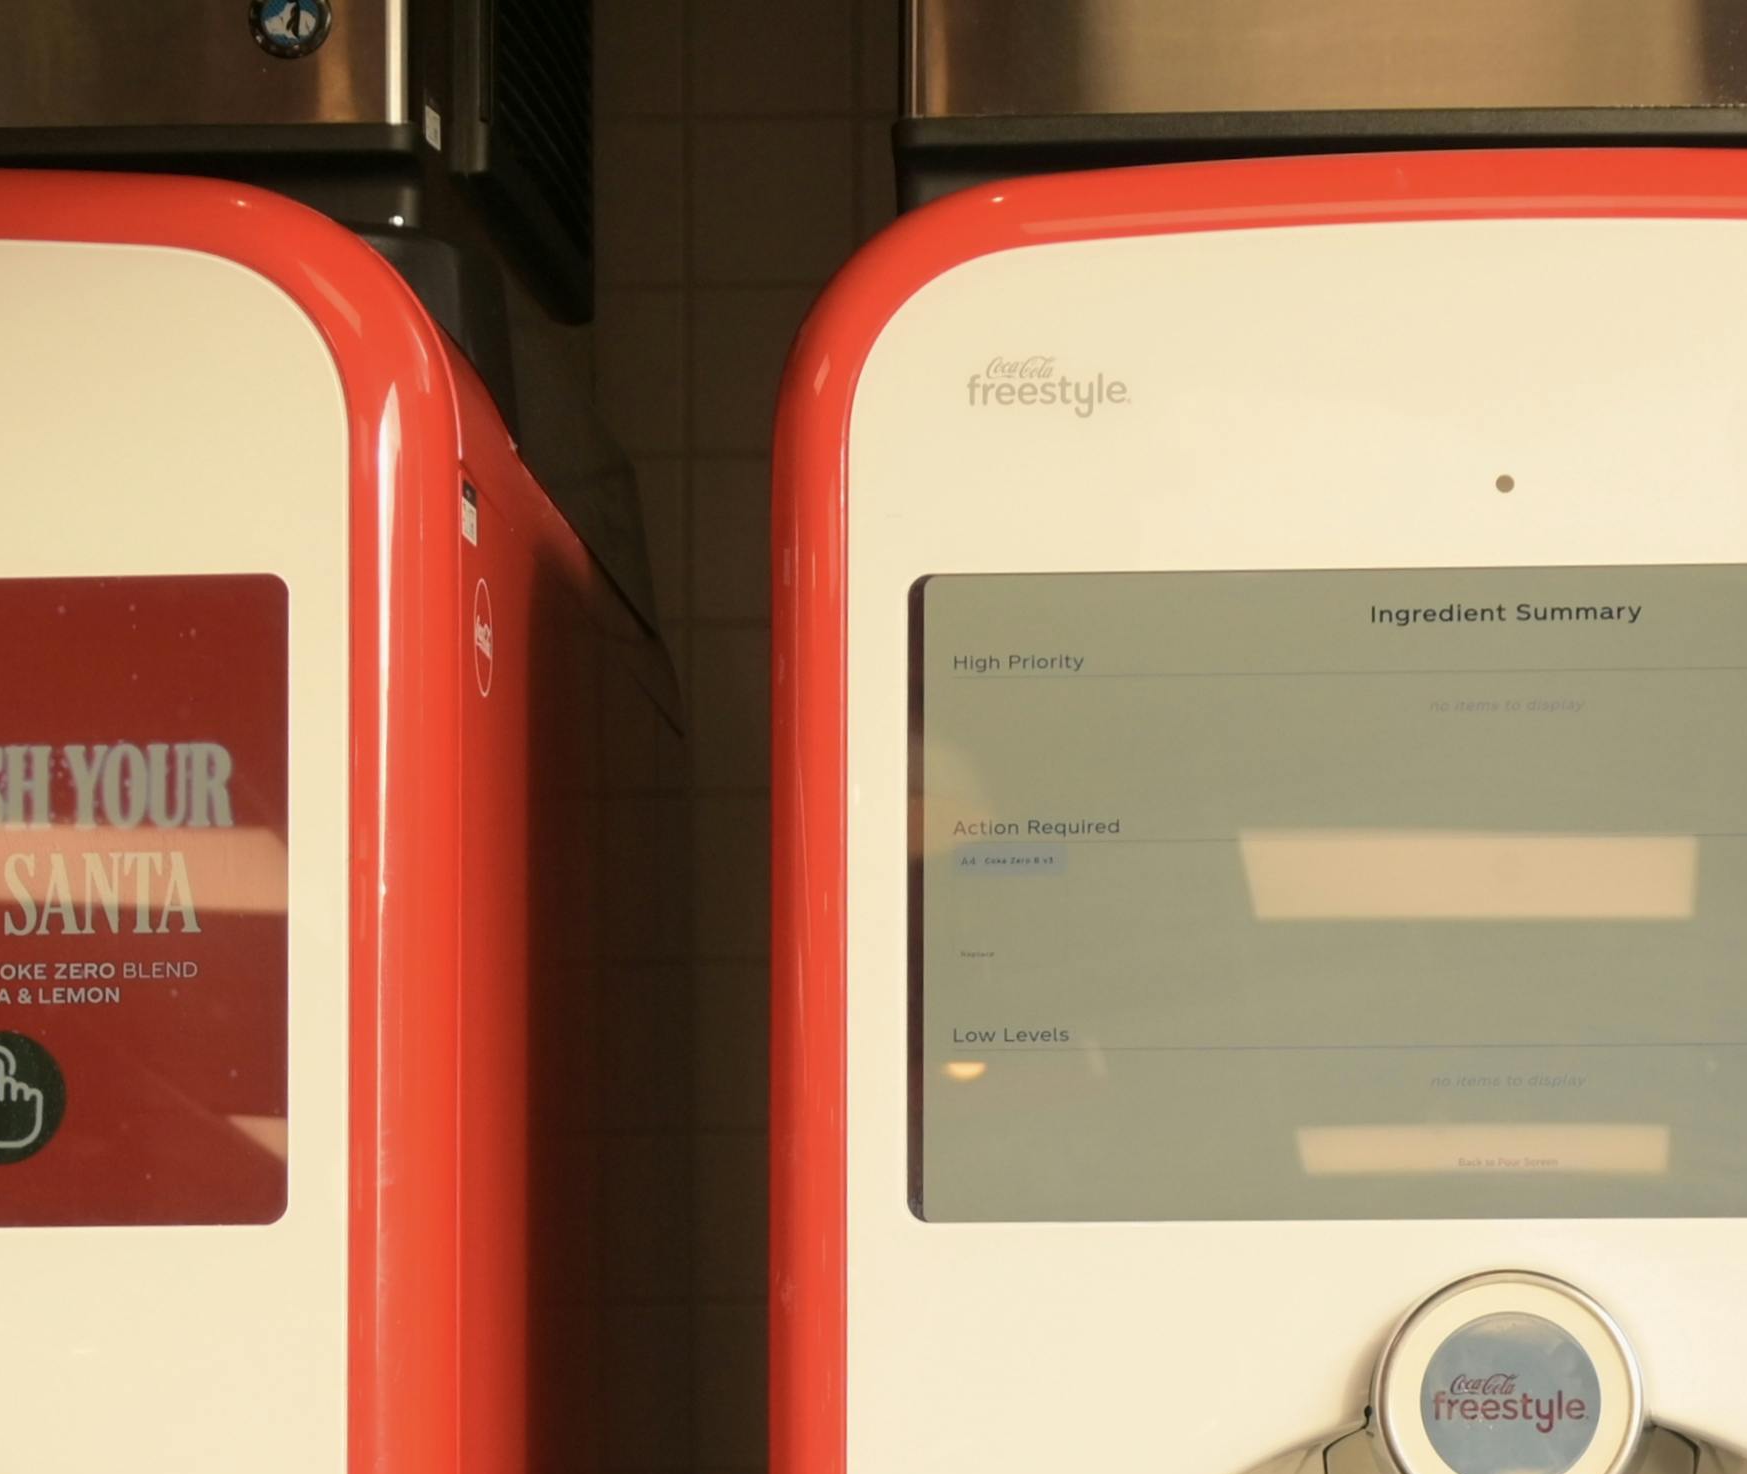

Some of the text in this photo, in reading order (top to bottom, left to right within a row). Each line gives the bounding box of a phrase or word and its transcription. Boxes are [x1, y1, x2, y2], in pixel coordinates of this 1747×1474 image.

[966, 372, 1128, 418] freestyle
[1370, 602, 1643, 626] Ingredient Summary
[952, 652, 1085, 673] High Priority
[64, 742, 234, 829] YOUR
[954, 819, 1120, 838] Action Required
[4, 851, 202, 936] SANTA
[54, 962, 116, 981] ZERO
[123, 961, 199, 980] BLEND
[17, 987, 33, 1005] &
[38, 986, 121, 1005] LEMON
[952, 1025, 1071, 1044] Low Levels
[1433, 1390, 1586, 1434] freestyle
